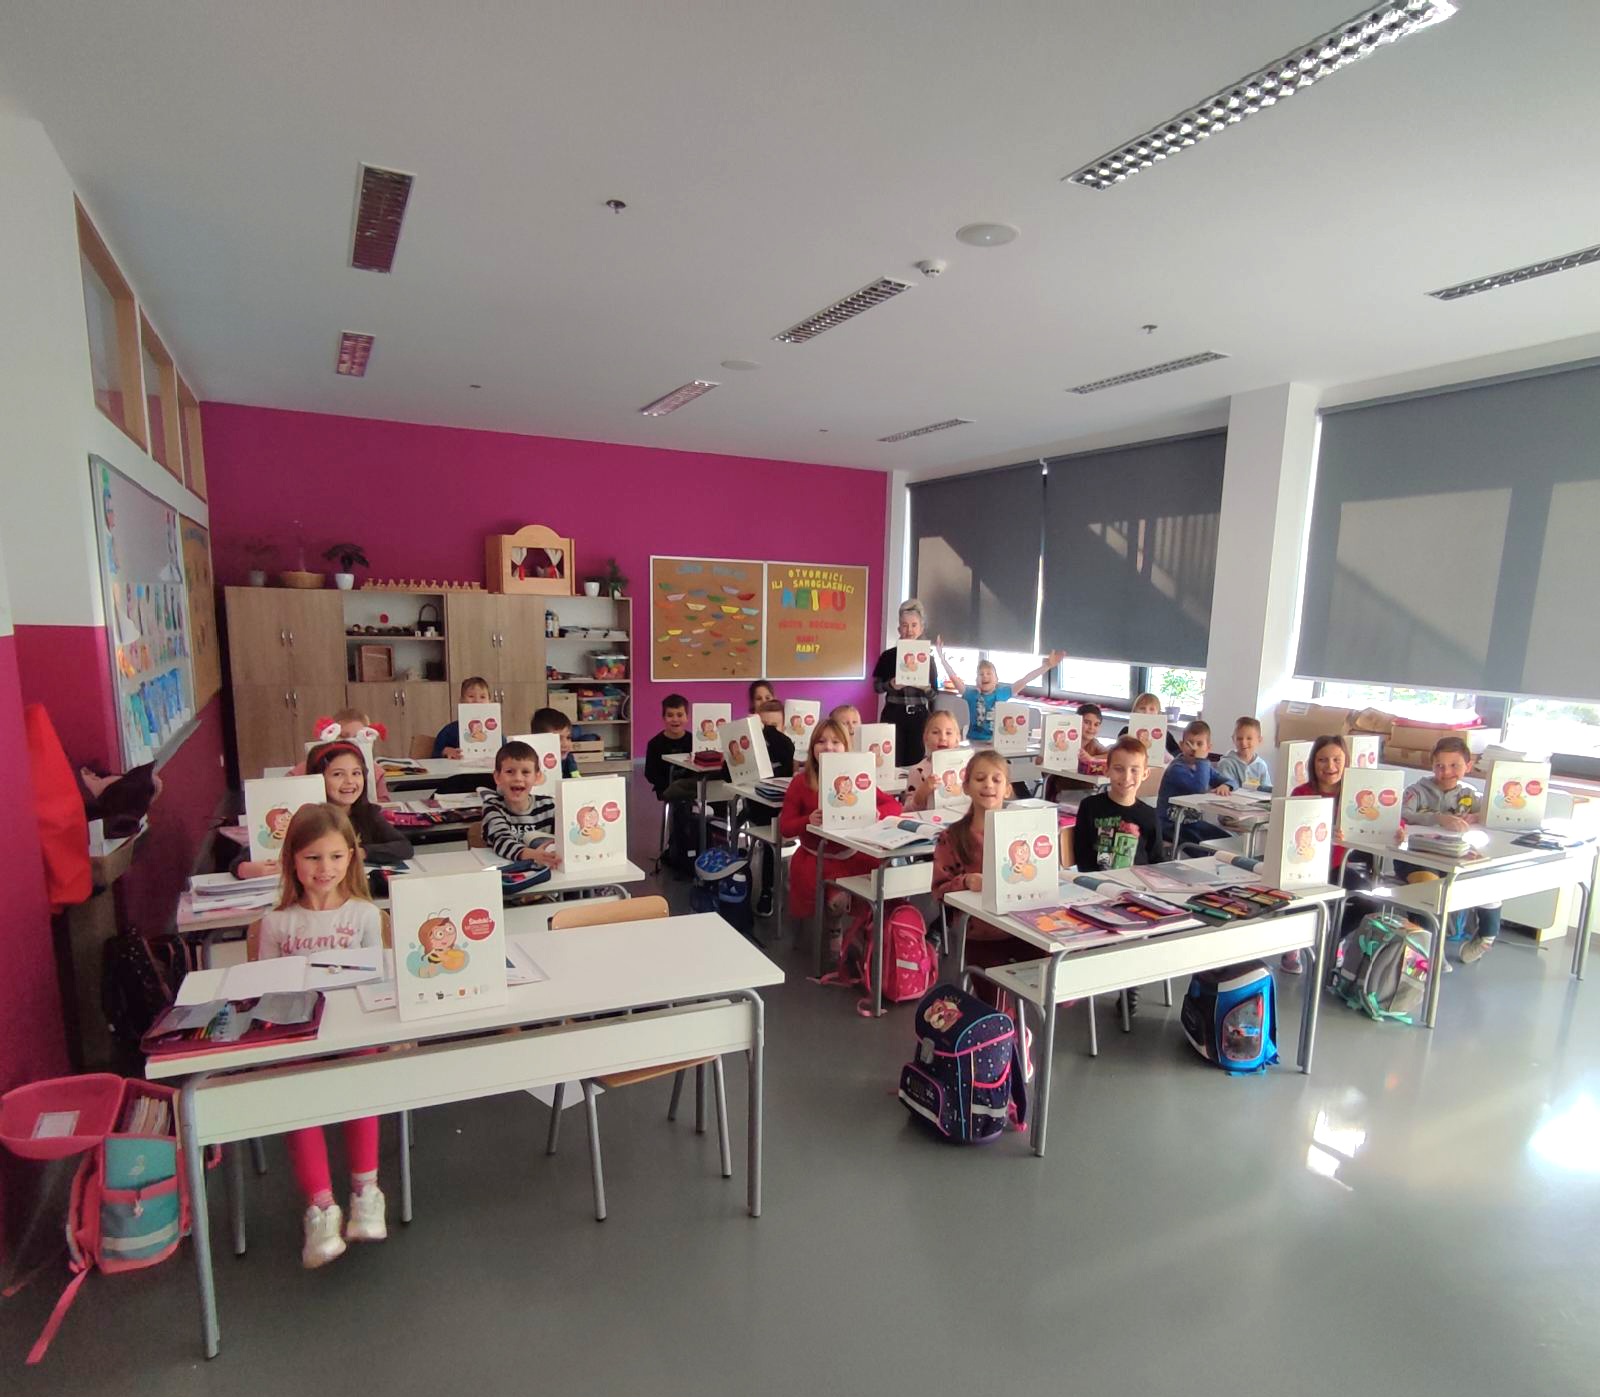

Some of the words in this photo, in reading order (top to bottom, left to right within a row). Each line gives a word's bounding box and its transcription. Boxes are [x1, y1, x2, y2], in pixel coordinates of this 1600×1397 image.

[788, 568, 843, 582] OTVORNICI
[771, 580, 783, 590] ILI
[793, 579, 855, 594] SAMOGLASNICI
[796, 643, 820, 653] RADI?
[282, 934, 351, 955] drama
